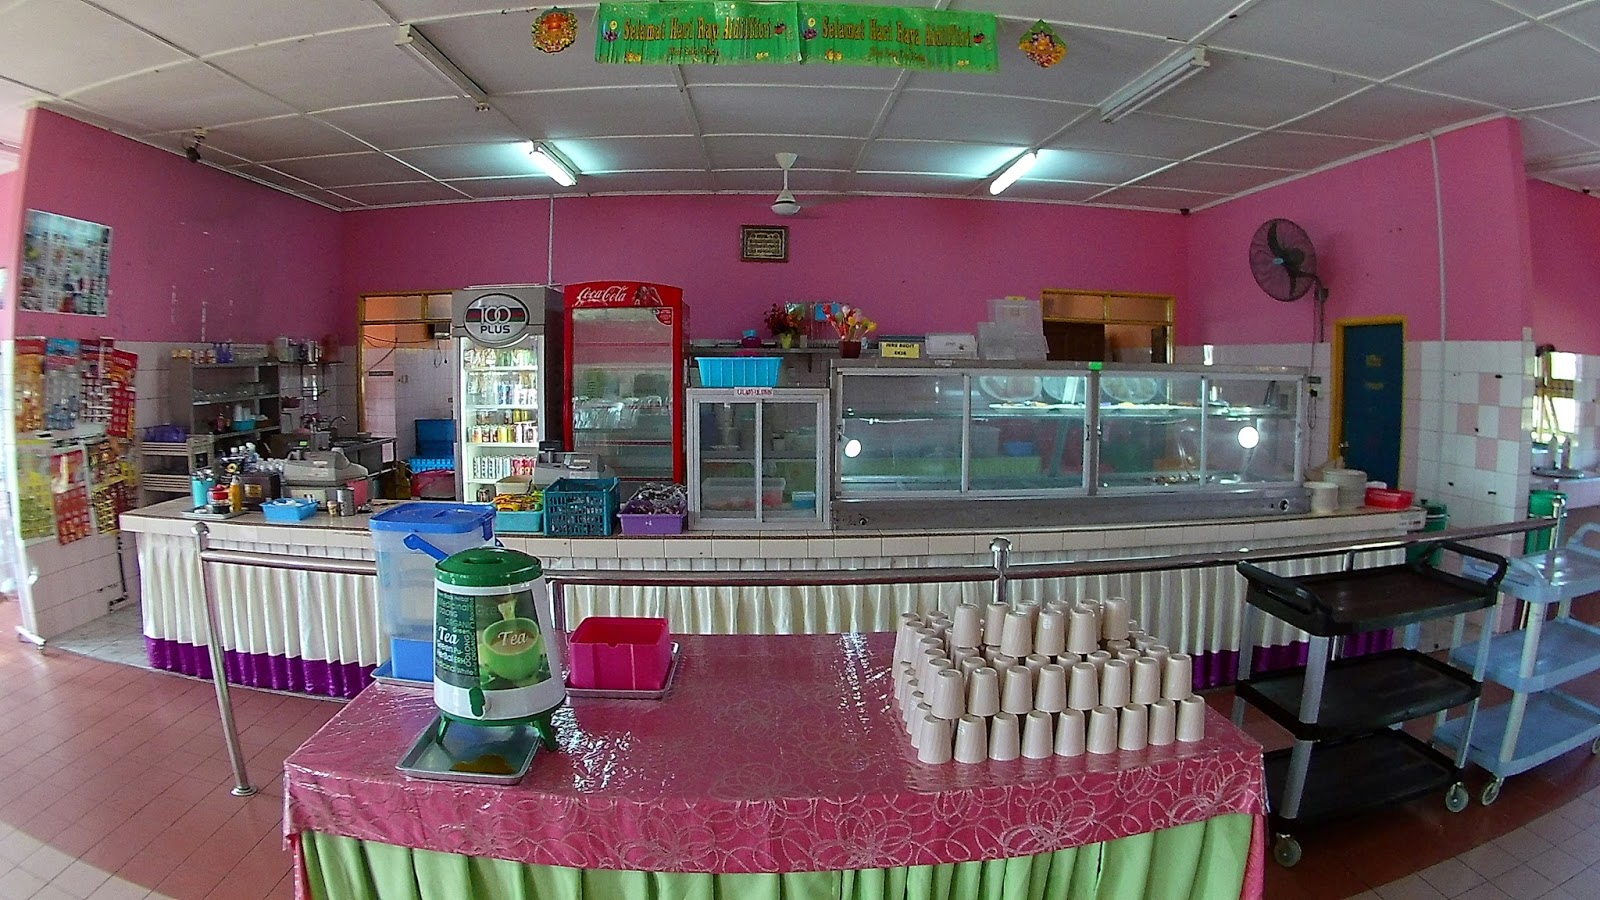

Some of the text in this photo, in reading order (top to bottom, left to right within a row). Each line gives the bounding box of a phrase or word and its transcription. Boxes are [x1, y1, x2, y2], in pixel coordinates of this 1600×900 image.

[624, 18, 665, 41] Selamat
[670, 17, 693, 40] Hari
[822, 16, 865, 40] Selamat
[869, 18, 893, 42] Hari
[480, 305, 511, 325] 100
[480, 325, 511, 334] PLUS
[438, 626, 460, 645] Tea
[497, 631, 529, 647] Tea
[464, 635, 472, 667] OOLONG
